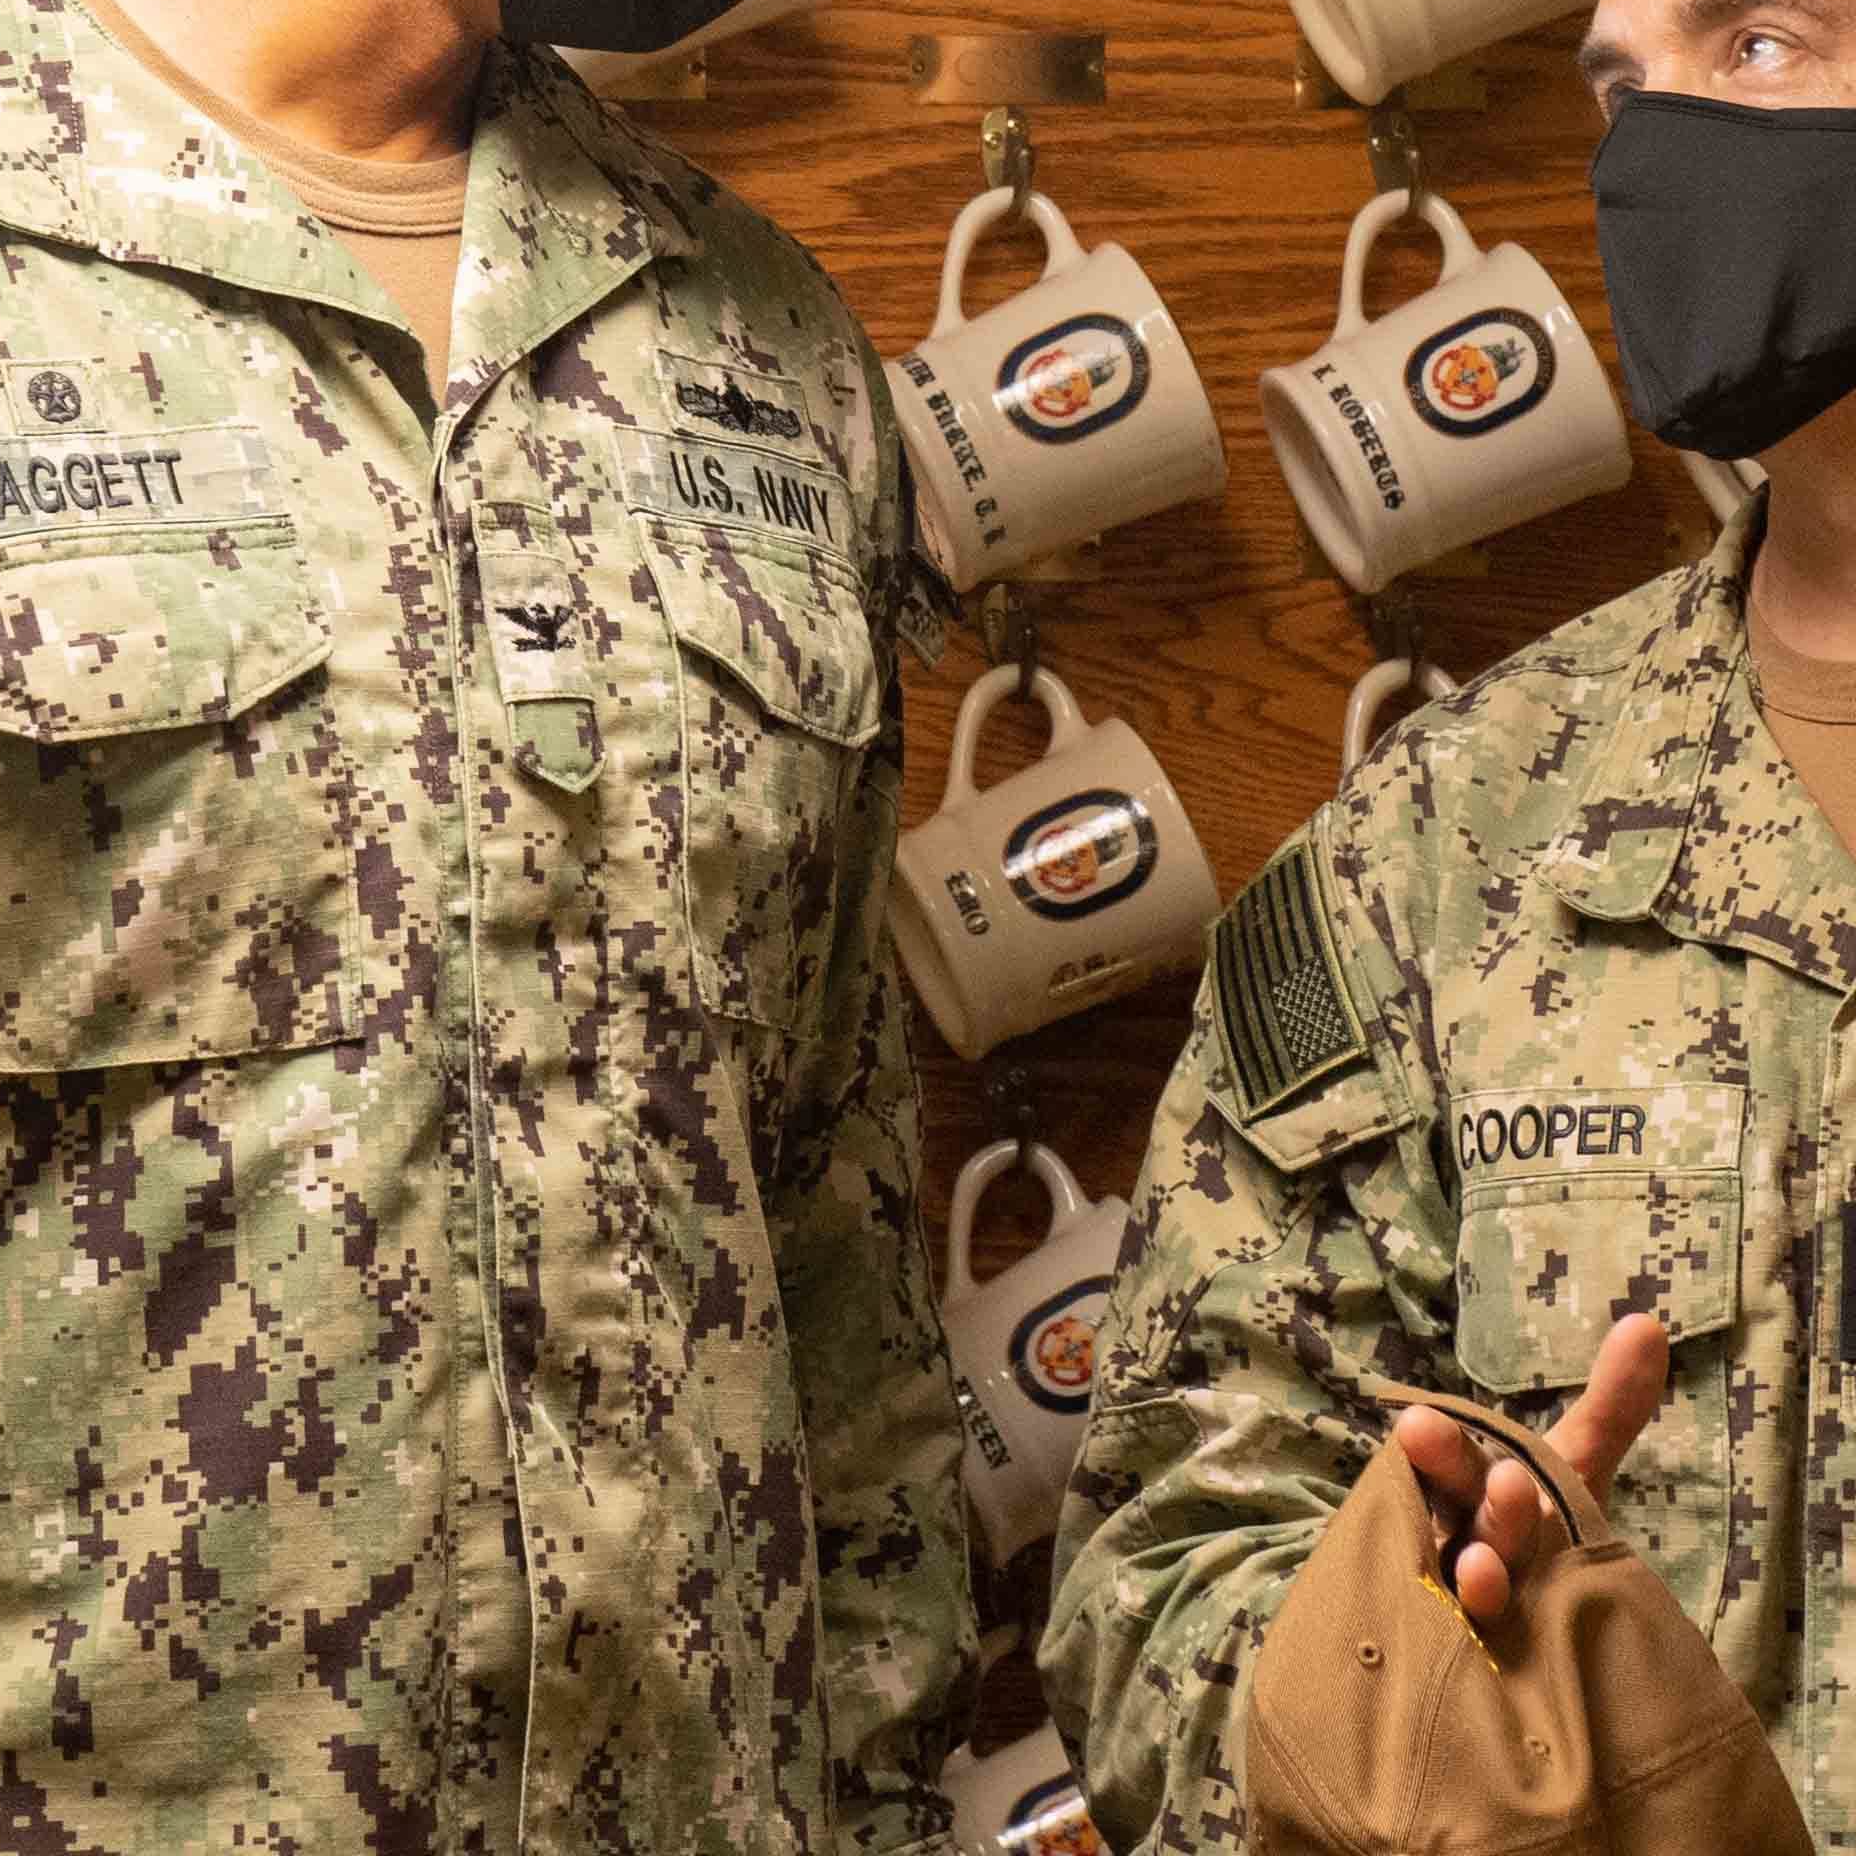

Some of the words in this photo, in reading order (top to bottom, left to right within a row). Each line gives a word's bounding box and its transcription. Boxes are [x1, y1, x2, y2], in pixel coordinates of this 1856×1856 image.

[669, 450, 745, 516] U.S.
[752, 464, 835, 544] NAVY
[1458, 1103, 1647, 1171] COOPER
